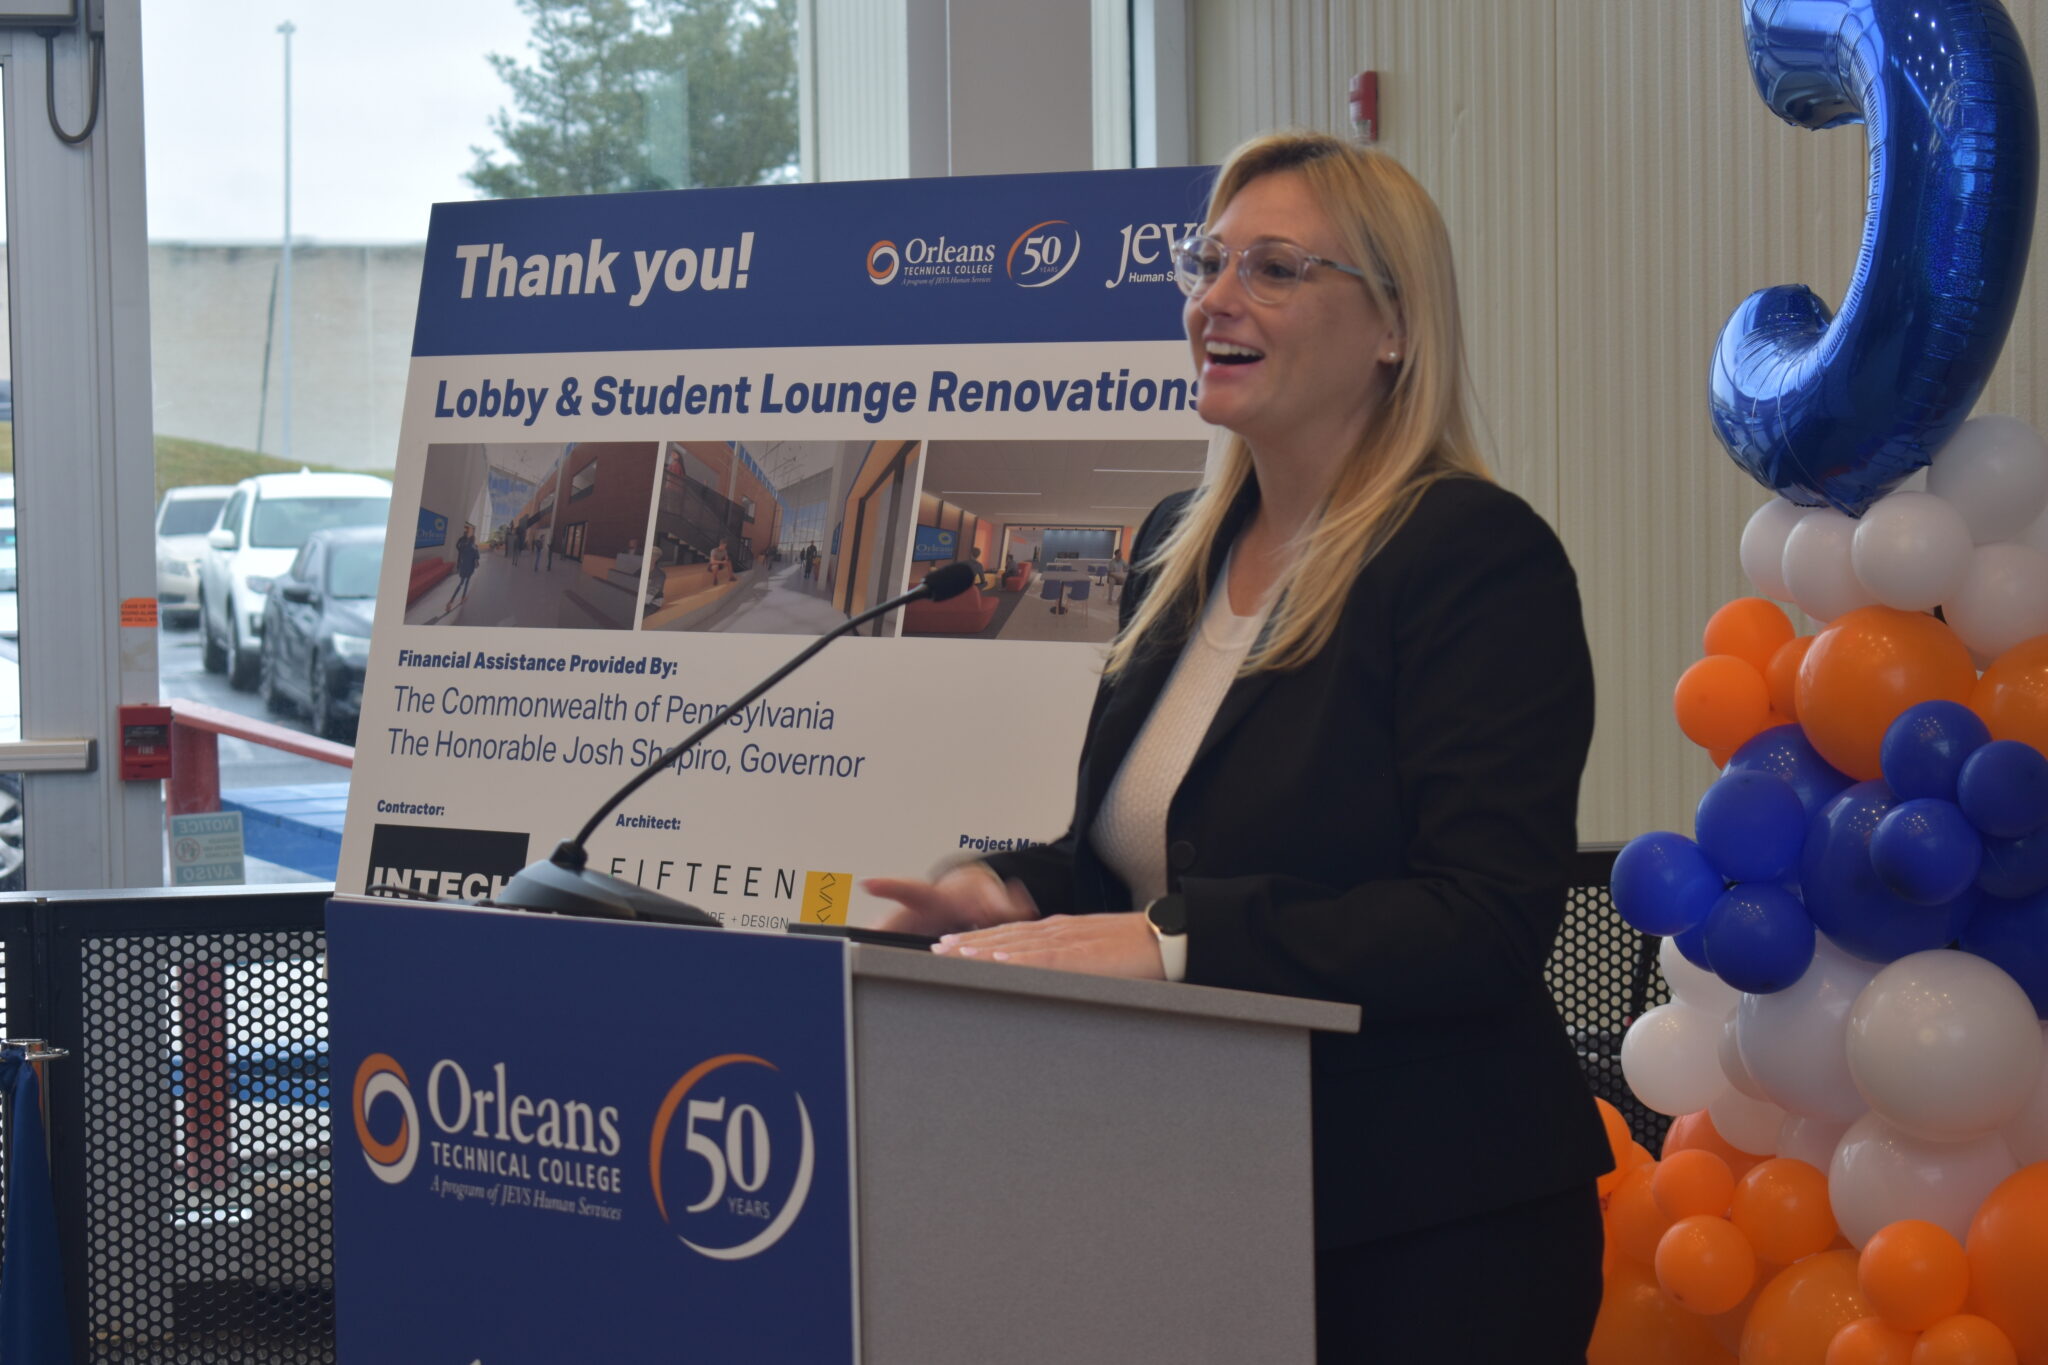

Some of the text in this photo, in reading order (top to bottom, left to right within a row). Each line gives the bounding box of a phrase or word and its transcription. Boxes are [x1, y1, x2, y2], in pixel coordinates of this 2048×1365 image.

[905, 236, 996, 264] Orleans
[1020, 234, 1062, 275] 50
[455, 231, 755, 307] Thank you!
[903, 264, 993, 276] TECHNICAL COLLEGE
[1128, 271, 1165, 283] Human
[434, 378, 549, 427] Lobby
[555, 376, 582, 418] &
[591, 374, 752, 417] Student
[760, 372, 917, 424] Lounge
[398, 649, 679, 679] Financial Assistance Provided By:
[394, 685, 435, 714] The
[441, 686, 628, 721] Commonwealth
[634, 694, 662, 722] of
[388, 727, 429, 757] The
[435, 730, 557, 763] Honorable
[562, 736, 624, 766] Josh
[740, 743, 866, 778] Governor
[376, 799, 445, 816] Contractor:
[616, 814, 681, 831] Architect:
[958, 834, 1014, 853] Project
[609, 857, 796, 900] FIFTEEN
[741, 914, 789, 930] DESIGN
[427, 1058, 621, 1157] Orleans
[430, 1141, 622, 1194] TECHNICAL COLLEGE
[685, 1096, 771, 1213] 50
[430, 1175, 623, 1221] A program of JEVS Human Services
[727, 1196, 771, 1220] YEARS
